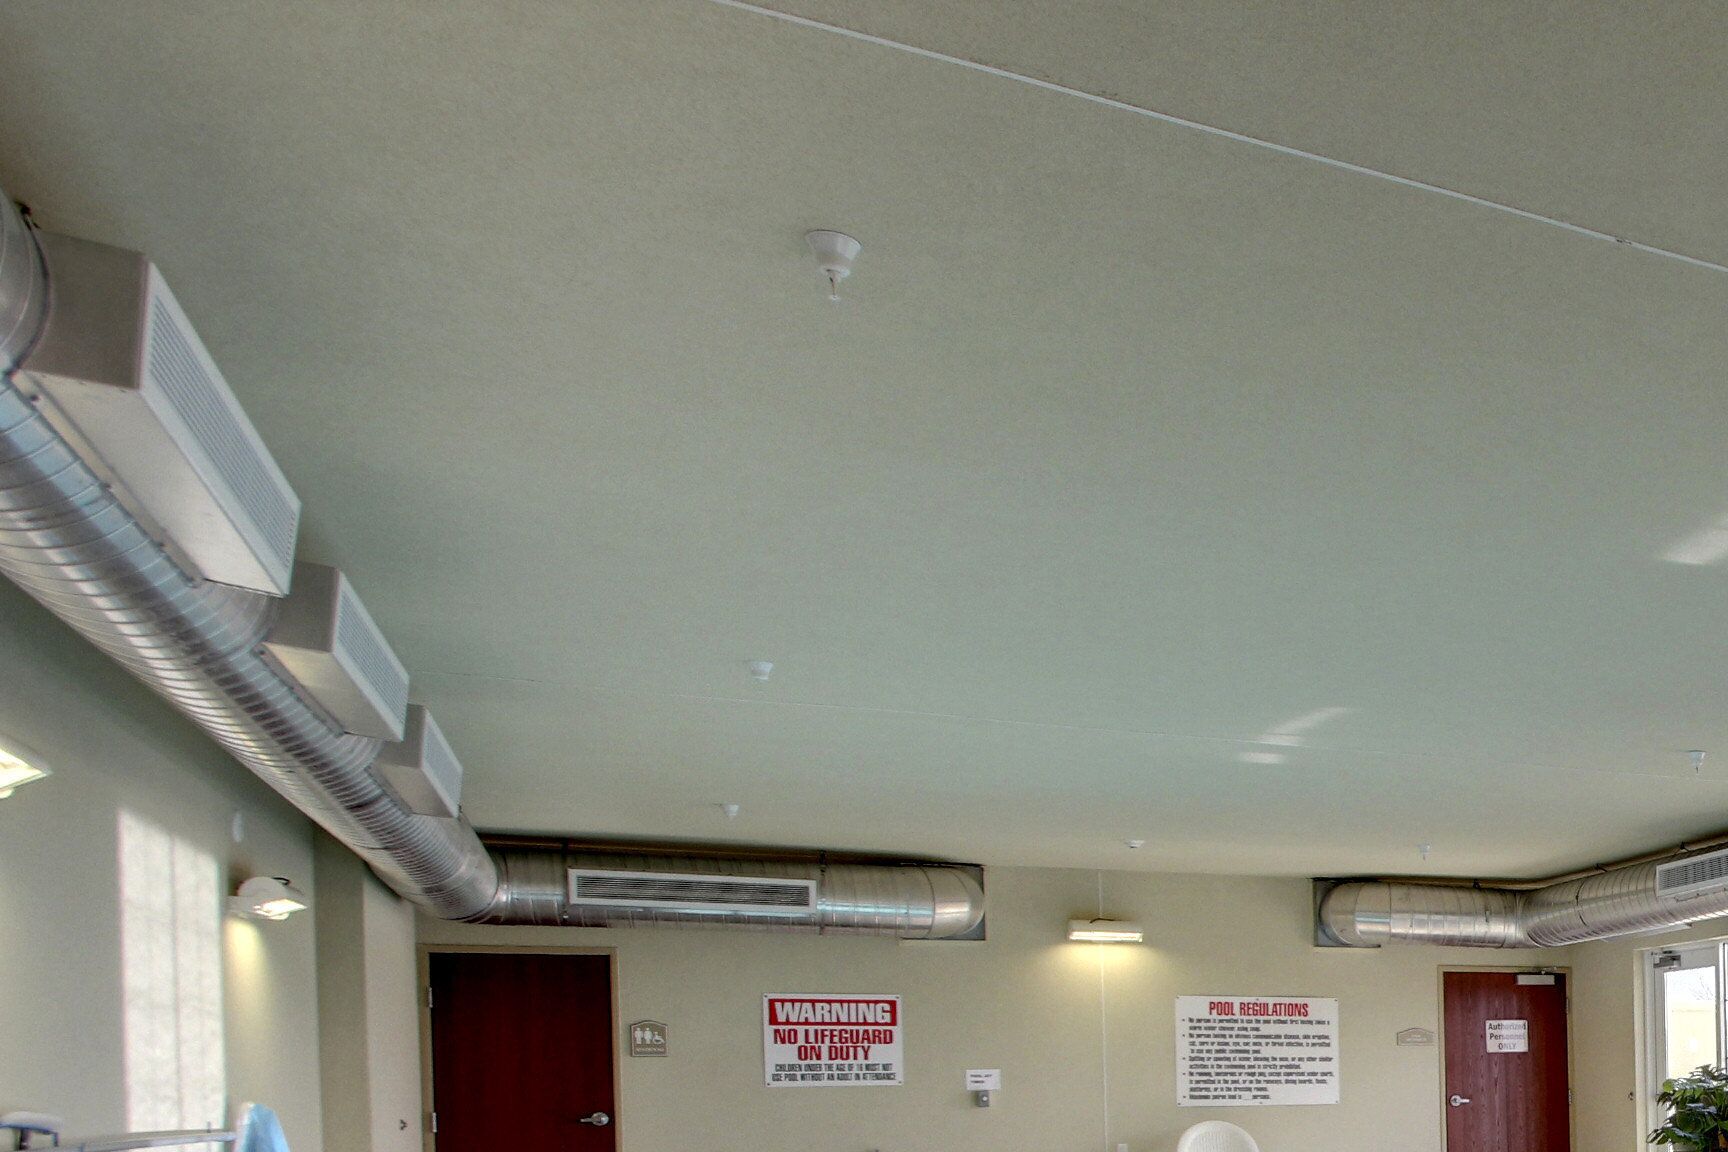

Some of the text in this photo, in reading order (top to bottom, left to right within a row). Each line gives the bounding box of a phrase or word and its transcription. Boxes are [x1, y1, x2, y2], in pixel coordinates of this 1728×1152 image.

[774, 1002, 892, 1023] WARNING
[1209, 1002, 1308, 1017] POOL REGULATIONS
[1488, 1022, 1526, 1030] Authorized
[774, 1029, 893, 1044] NO LIFEGUARD
[798, 1046, 871, 1060] ON DUTY
[775, 1064, 802, 1072] CHILDREN
[785, 1073, 798, 1081] POOL
[800, 1073, 825, 1081] WITHOUT
